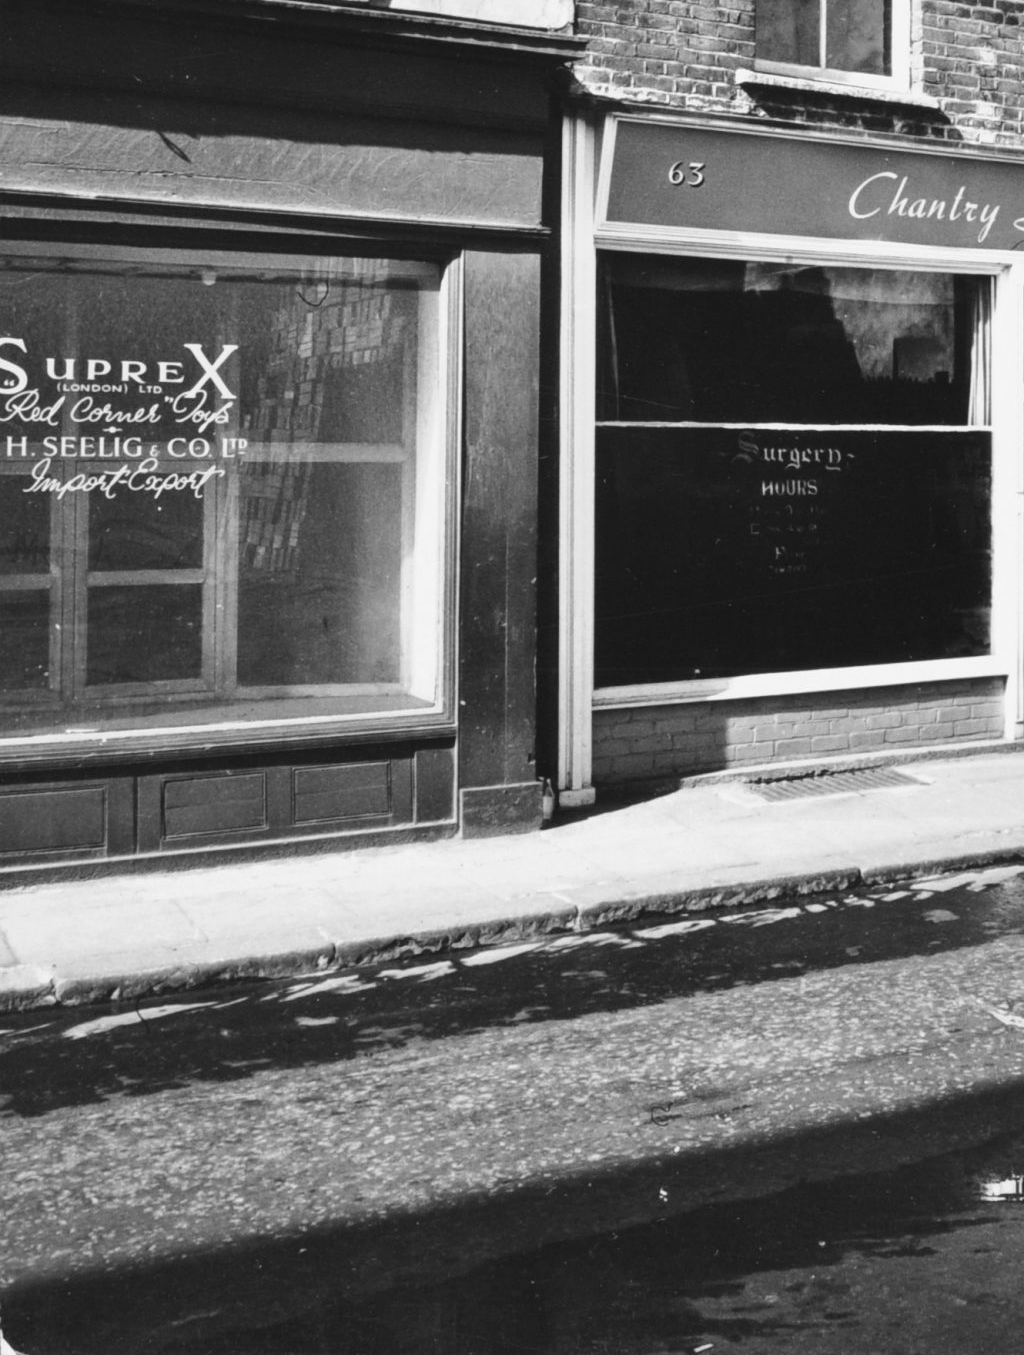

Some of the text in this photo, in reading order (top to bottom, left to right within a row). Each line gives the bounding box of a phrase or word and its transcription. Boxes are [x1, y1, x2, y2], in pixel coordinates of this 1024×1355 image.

[667, 161, 706, 187] 63
[848, 171, 1000, 243] Chantry
[56, 383, 128, 394] (LONDON)
[172, 389, 234, 433] Toys
[6, 436, 36, 457] H.
[43, 436, 143, 458] SEELIG
[149, 444, 161, 458] &
[167, 437, 213, 458] CO.
[22, 457, 226, 500] Import-Export
[761, 479, 819, 496] HOURS
